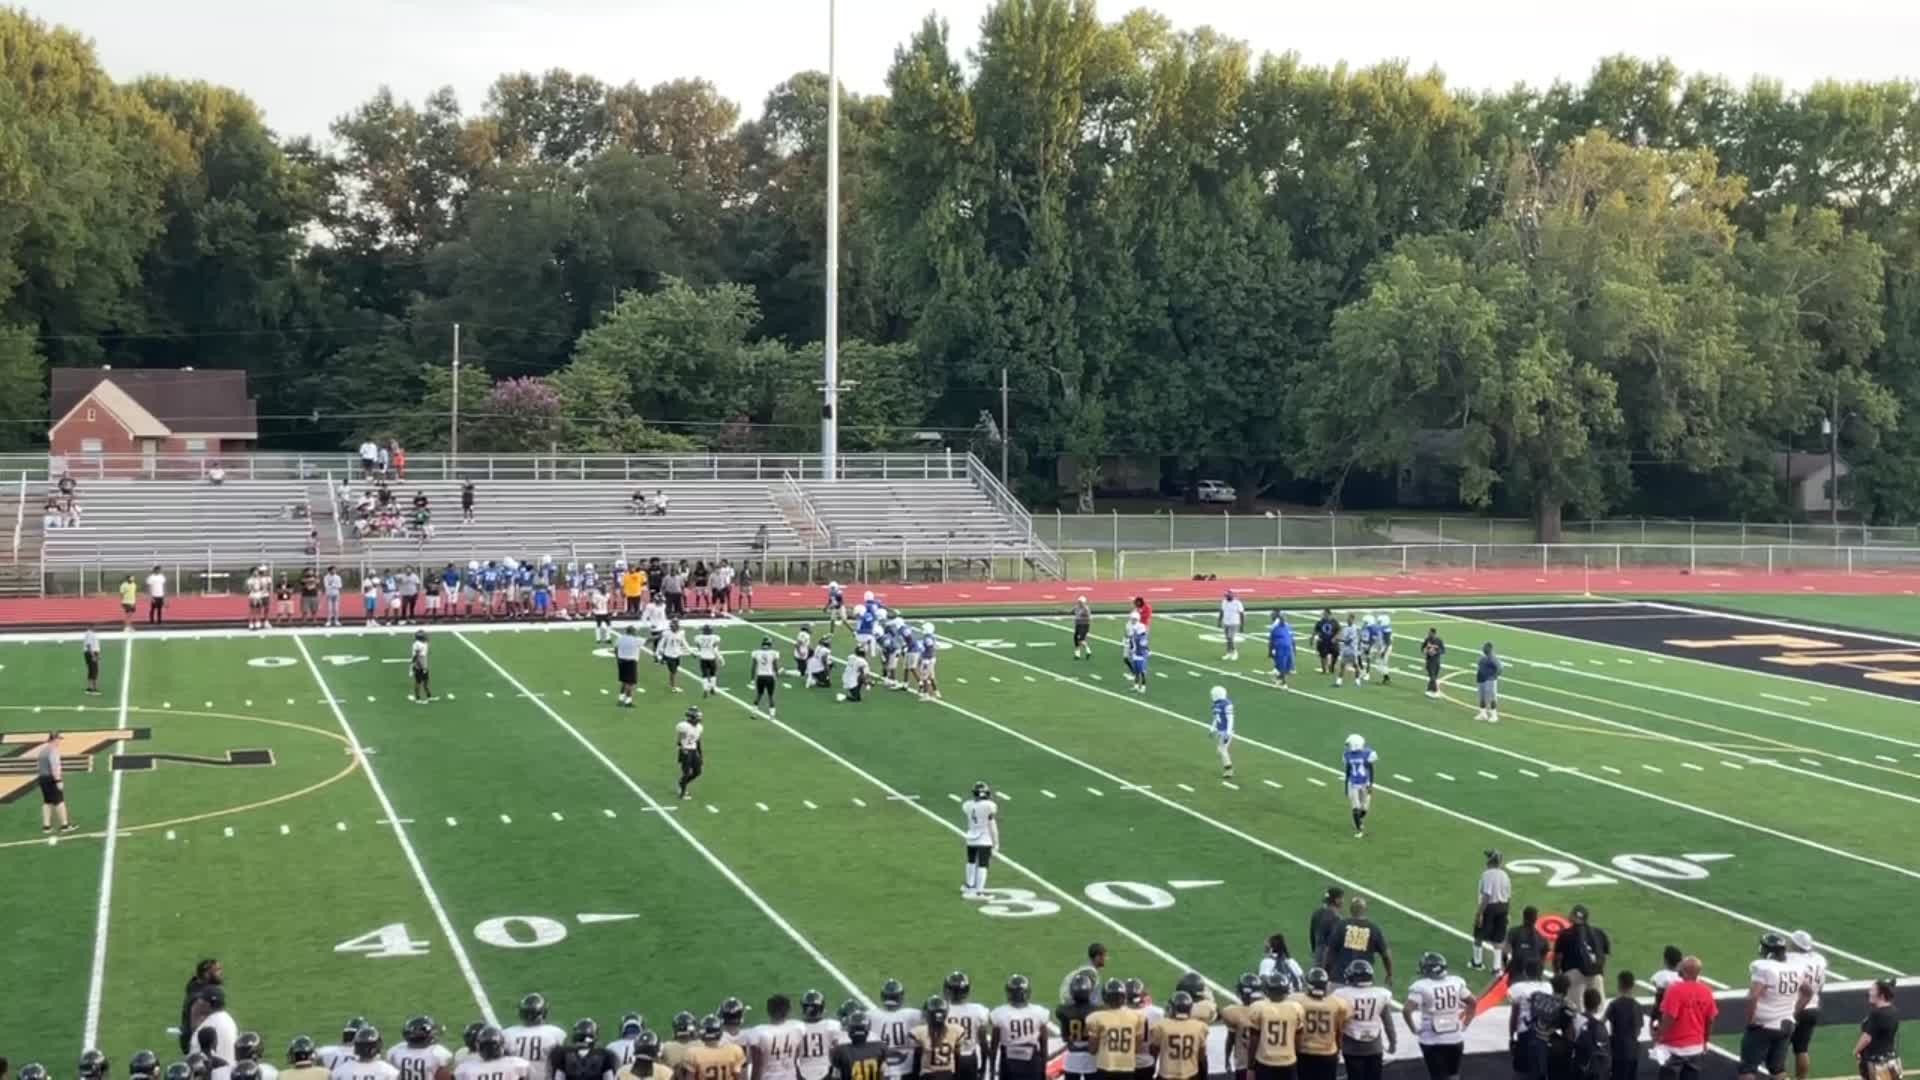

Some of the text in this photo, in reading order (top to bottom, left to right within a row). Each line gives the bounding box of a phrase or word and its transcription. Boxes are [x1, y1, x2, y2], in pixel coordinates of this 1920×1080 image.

[1778, 972, 1799, 994] 65
[1354, 998, 1377, 1022] 57
[1434, 985, 1457, 1010] 56
[1010, 1018, 1035, 1040] 90
[1267, 1020, 1289, 1047] 51
[1305, 1009, 1332, 1034] 55
[770, 1034, 793, 1059] 44
[802, 1033, 824, 1058] 13
[881, 1022, 905, 1047] 40
[516, 1036, 542, 1061] 78
[1168, 1034, 1195, 1061] 58
[401, 1057, 426, 1080] 69
